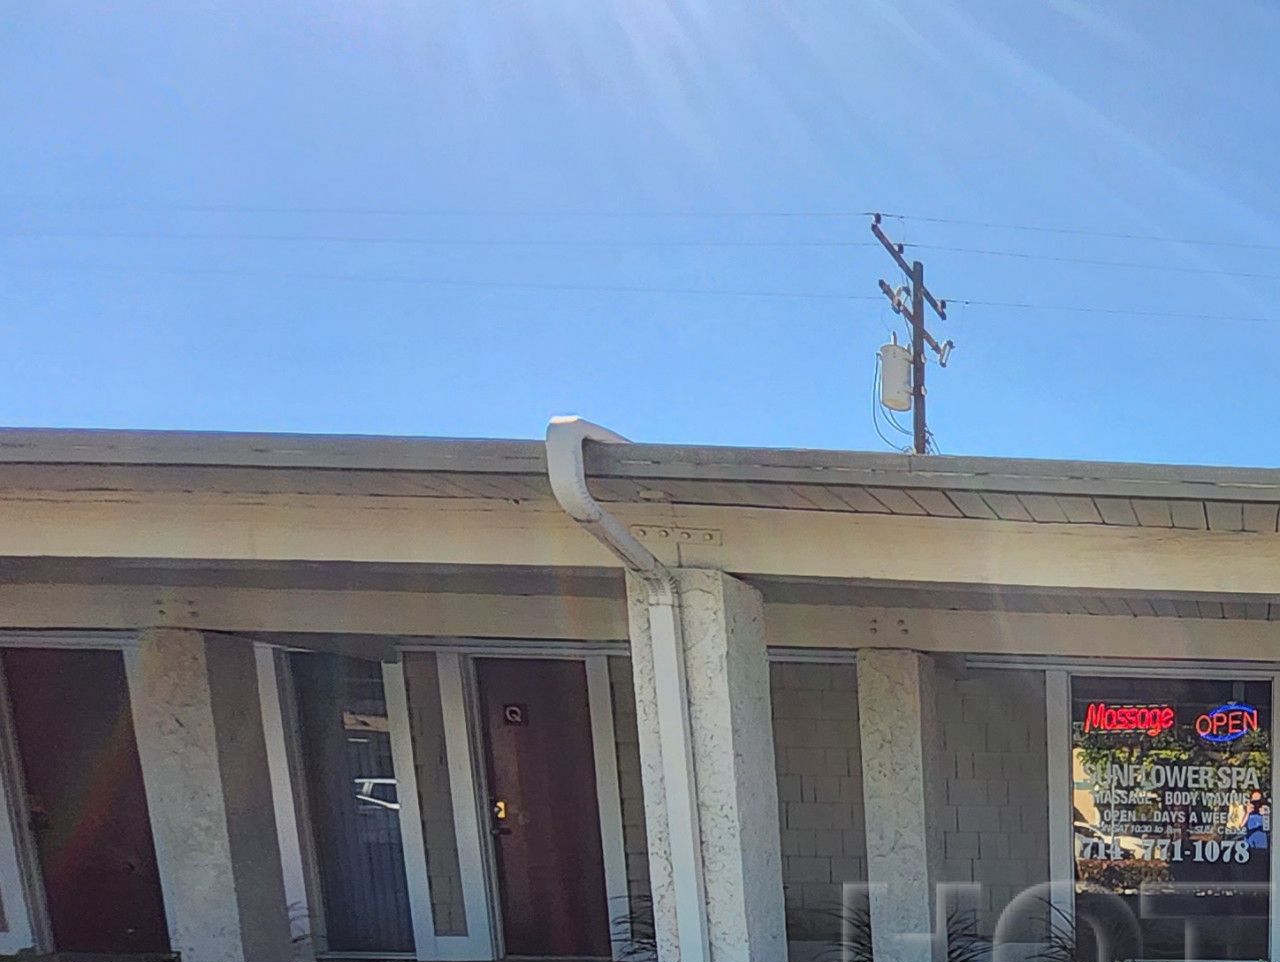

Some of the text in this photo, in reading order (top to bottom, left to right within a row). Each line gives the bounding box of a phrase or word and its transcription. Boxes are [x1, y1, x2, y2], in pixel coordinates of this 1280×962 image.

[506, 706, 521, 722] Q
[1085, 704, 1175, 736] Massage
[1195, 710, 1257, 737] OPEN
[1084, 763, 1260, 790] SUNFLOWER SPA
[1164, 791, 1200, 806] BODY
[1103, 809, 1136, 822] OPEN
[1153, 810, 1186, 823] DAYS
[1189, 811, 1198, 823] A
[1201, 811, 1235, 824] WEE
